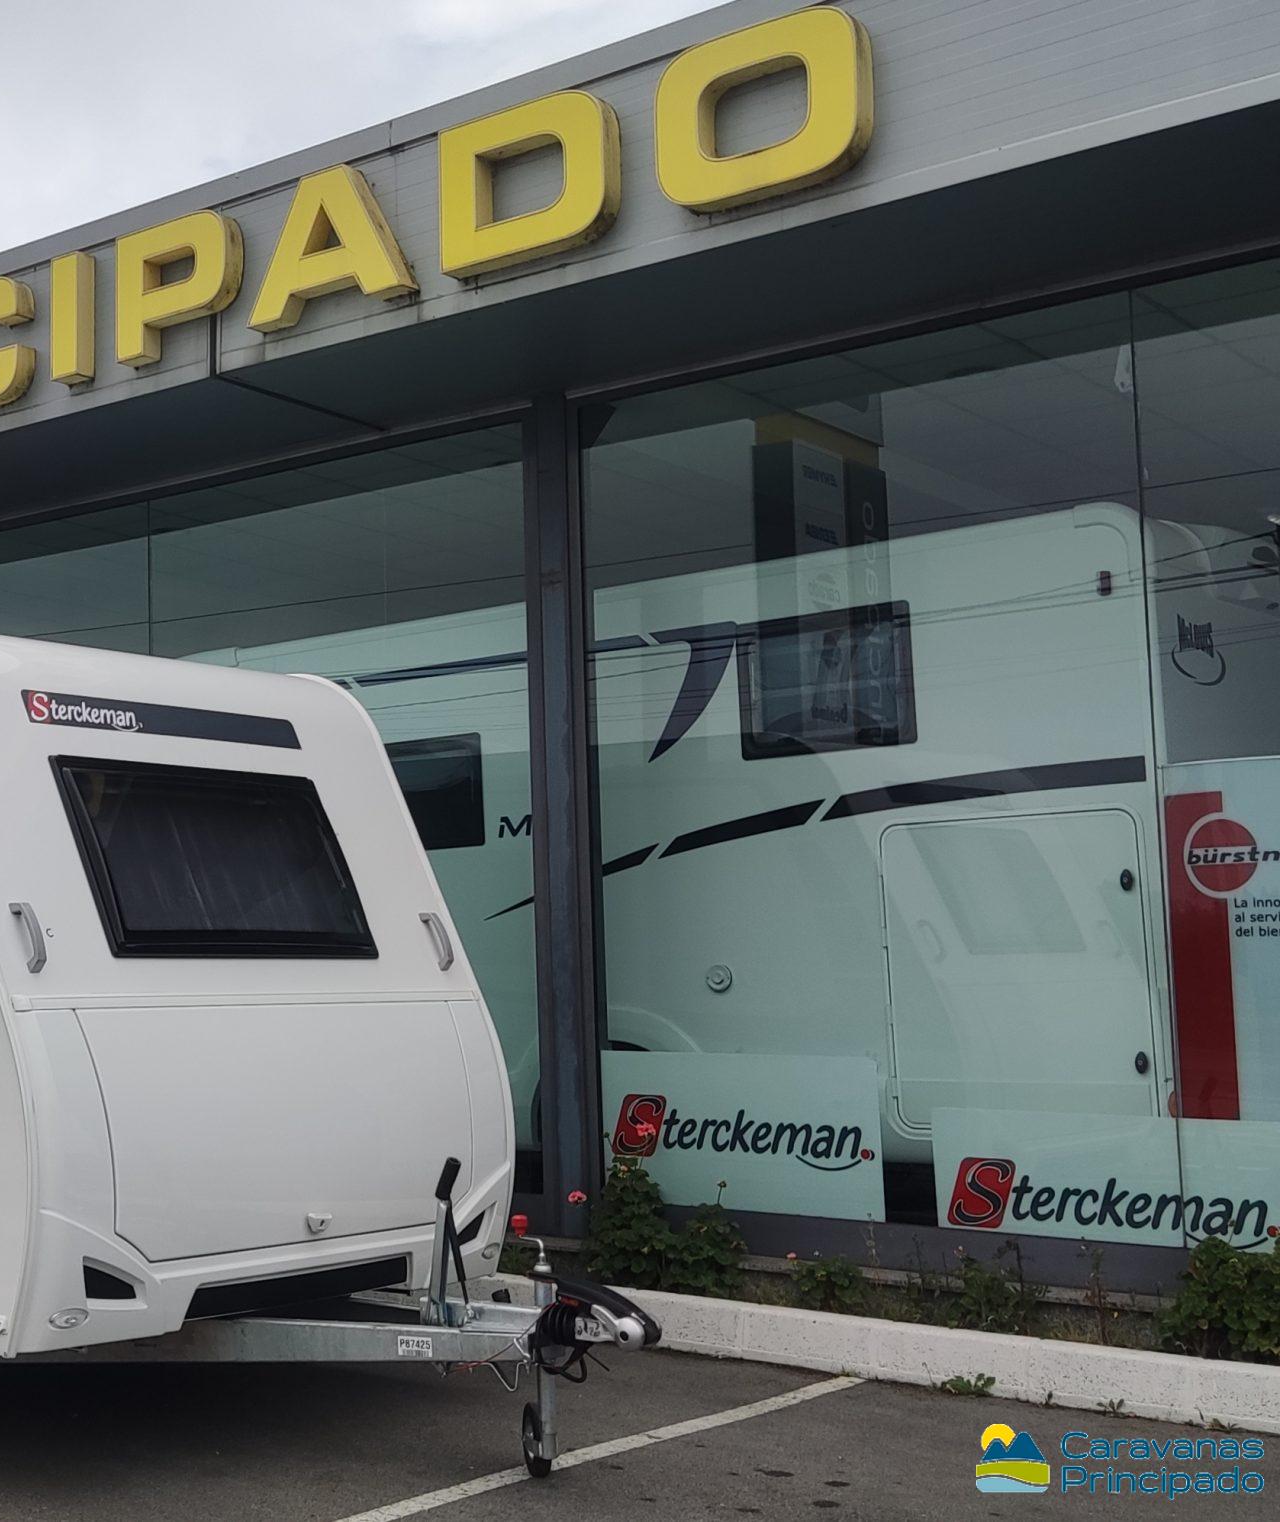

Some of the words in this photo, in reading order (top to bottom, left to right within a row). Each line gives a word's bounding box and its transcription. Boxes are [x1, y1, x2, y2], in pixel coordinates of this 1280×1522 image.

[1234, 898, 1248, 908] La
[1234, 913, 1245, 923] al
[1235, 926, 1254, 938] del
[399, 1338, 431, 1350] P87425
